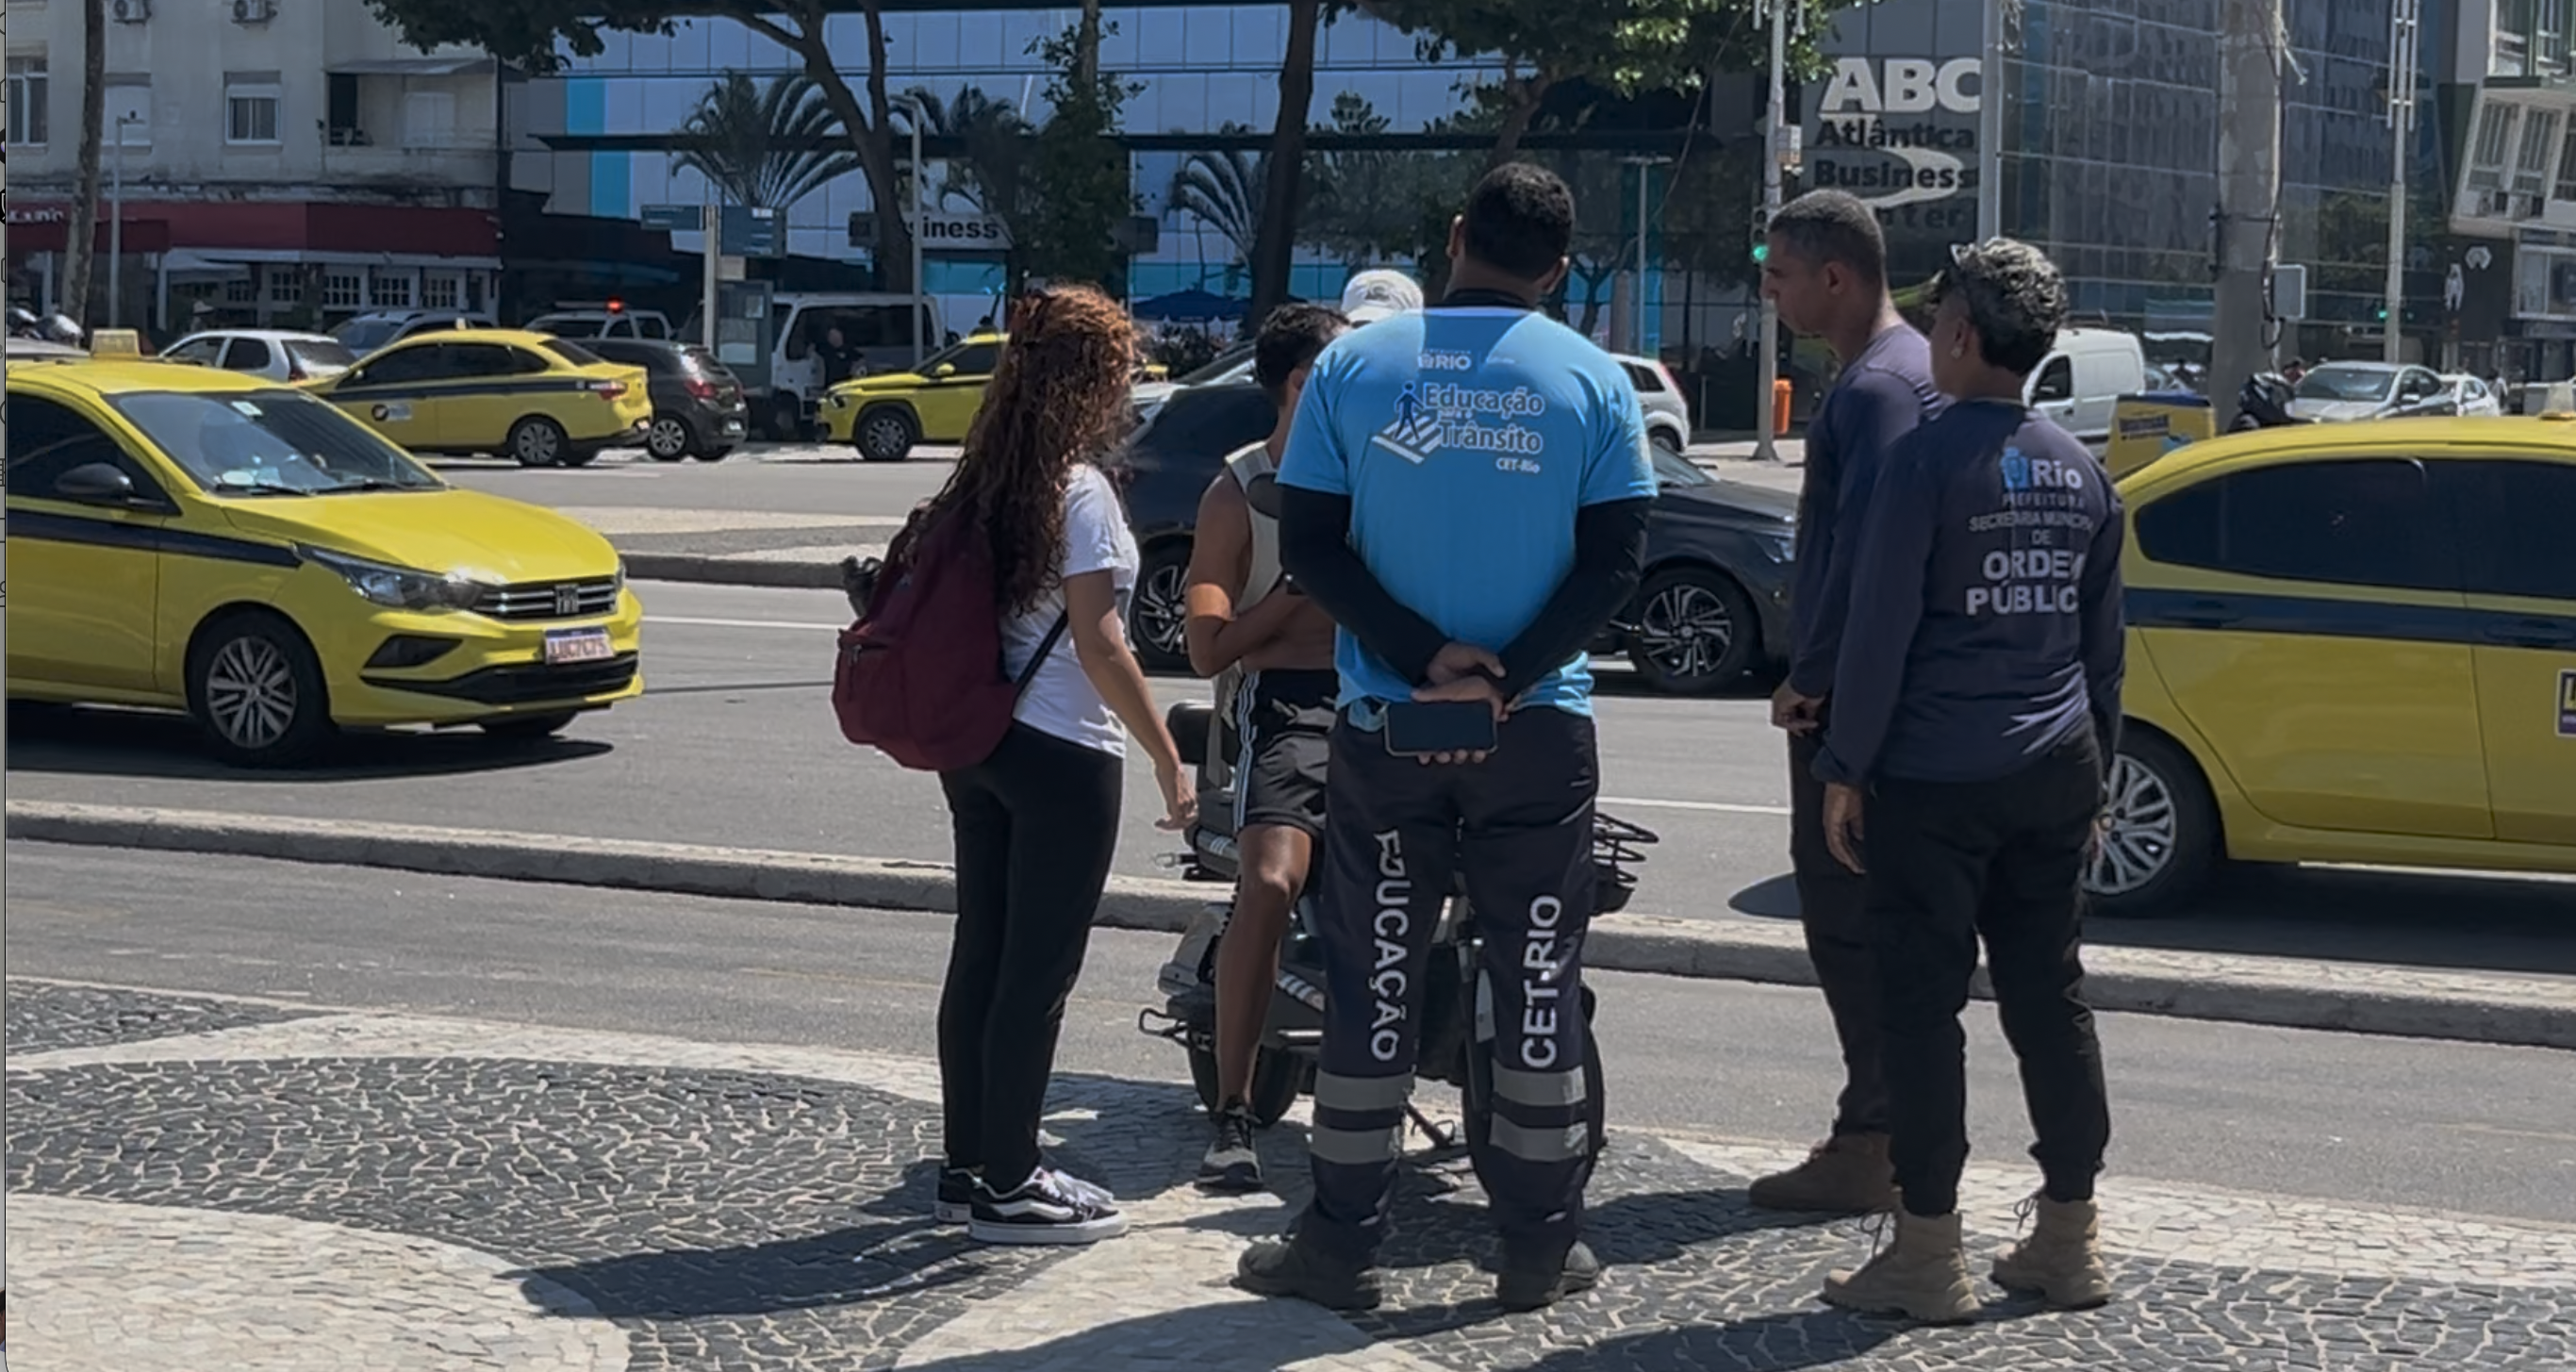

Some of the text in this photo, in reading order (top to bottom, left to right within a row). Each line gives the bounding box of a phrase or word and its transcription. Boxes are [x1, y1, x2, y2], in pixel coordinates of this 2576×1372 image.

[1820, 57, 1981, 113] ABC
[1815, 118, 1974, 147] Atlântica
[1435, 355, 1472, 371] RIO
[1424, 382, 1544, 420] Educação
[1438, 421, 1543, 455] Trânsito
[2031, 458, 2083, 489] Rio
[2032, 529, 2053, 546] DE
[1966, 580, 2079, 615] PÚBLIC
[1521, 895, 1562, 1068] CET-RIO
